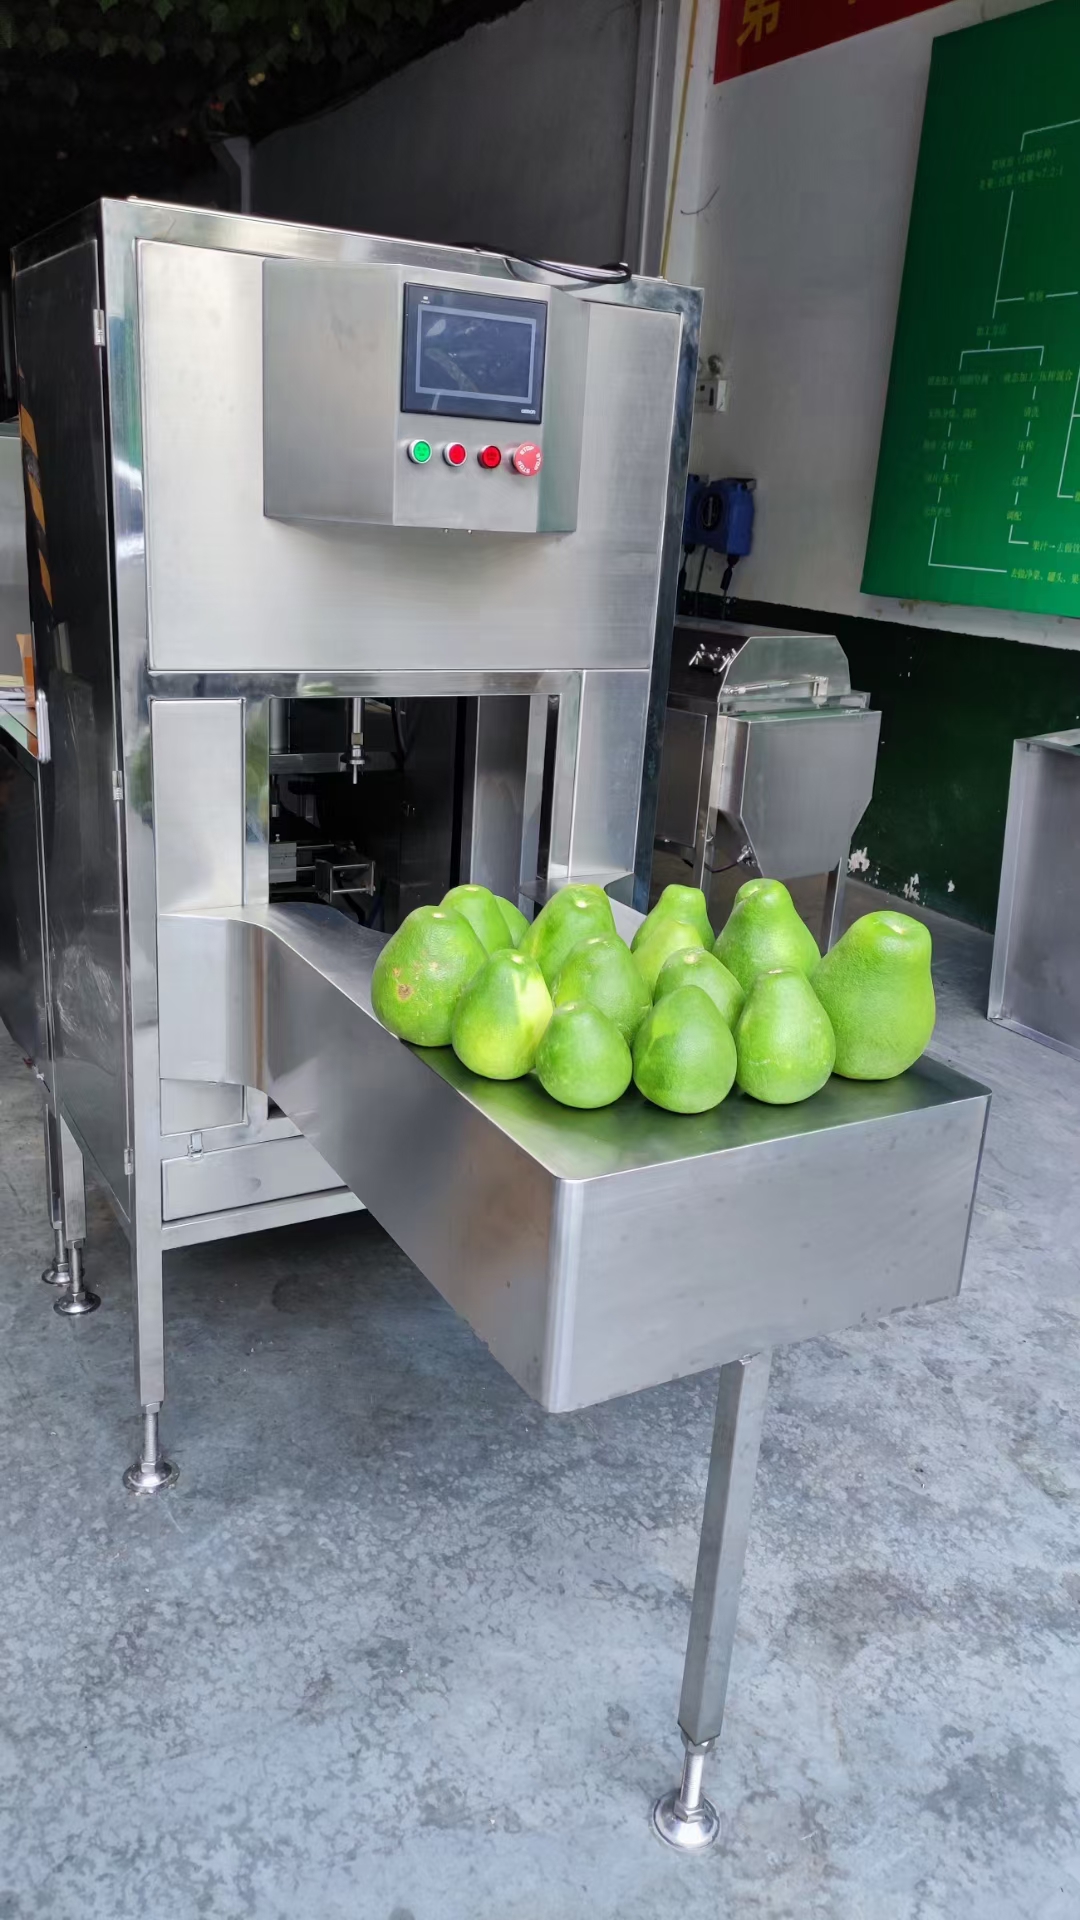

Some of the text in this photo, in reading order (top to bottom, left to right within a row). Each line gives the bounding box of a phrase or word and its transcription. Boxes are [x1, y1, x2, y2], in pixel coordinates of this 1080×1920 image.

[519, 445, 535, 455] STOP
[517, 460, 531, 474] STOP
[534, 453, 542, 471] STOP
